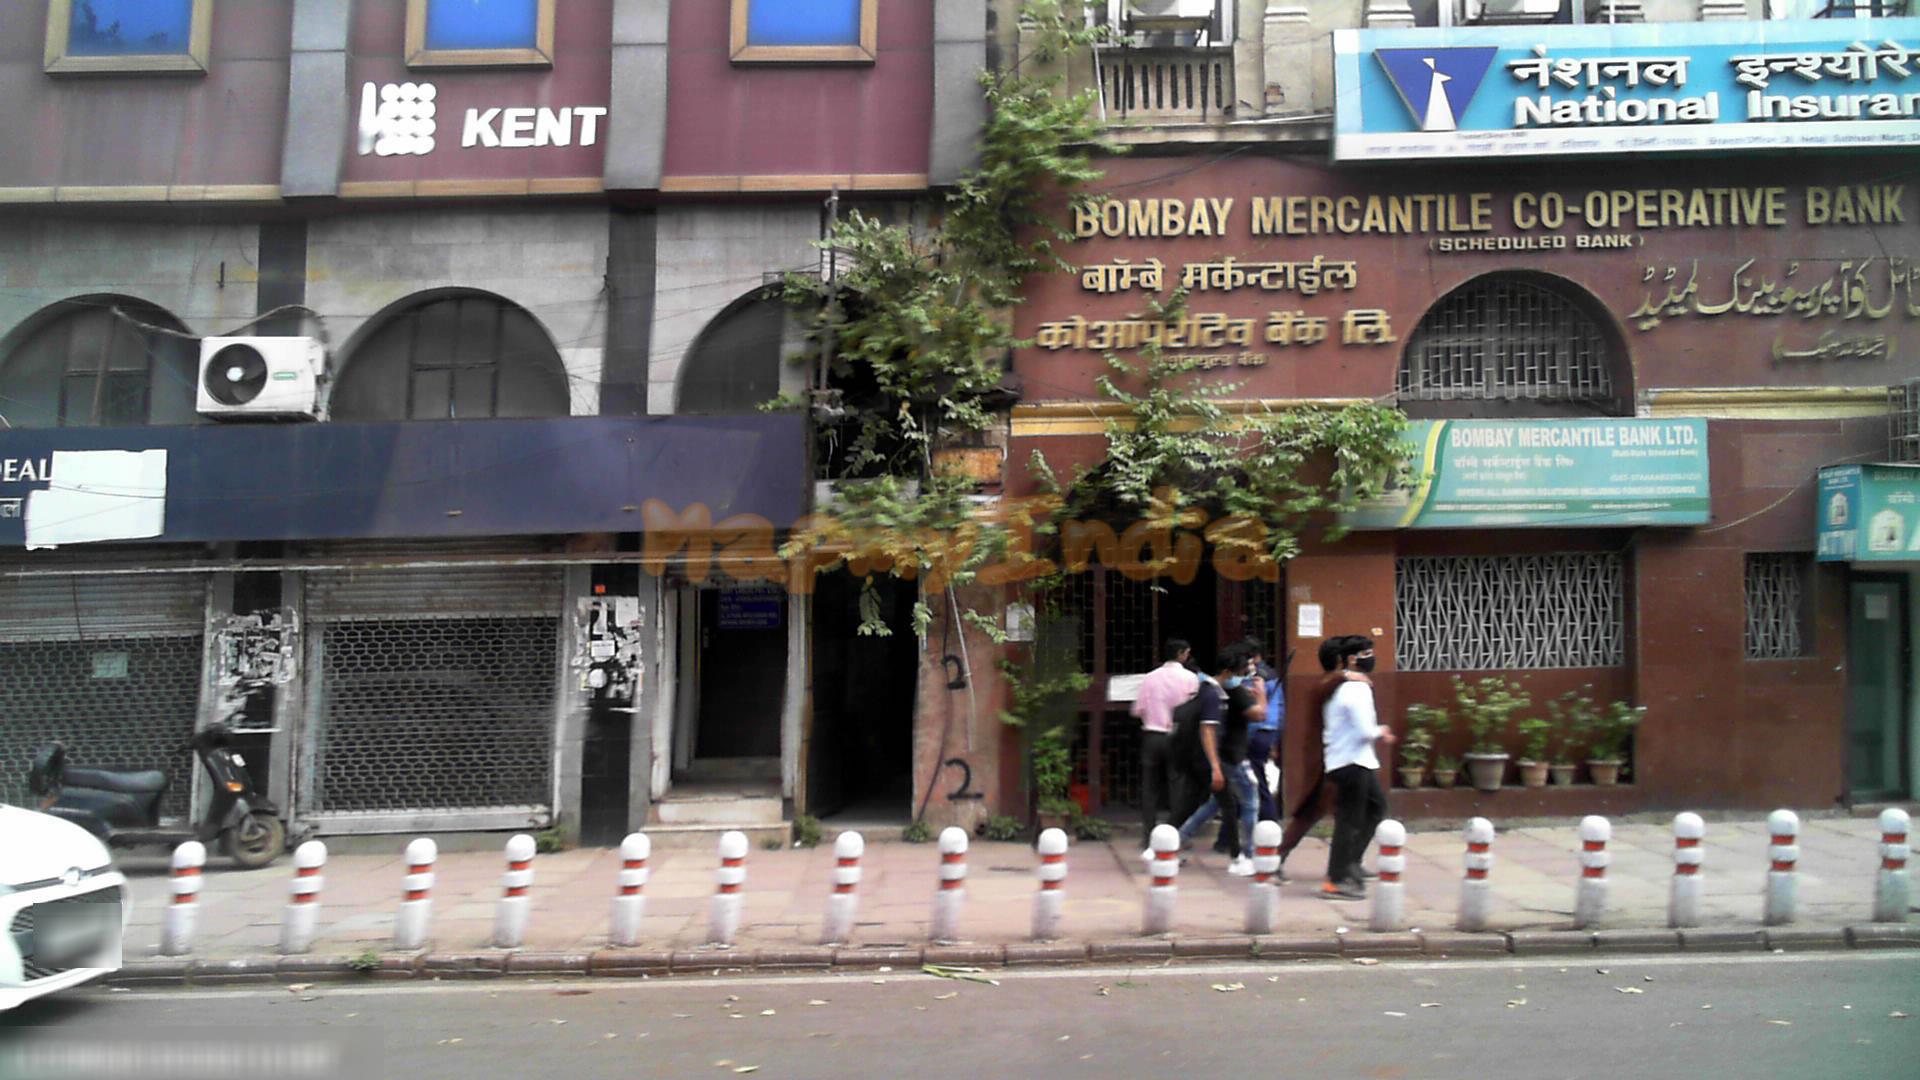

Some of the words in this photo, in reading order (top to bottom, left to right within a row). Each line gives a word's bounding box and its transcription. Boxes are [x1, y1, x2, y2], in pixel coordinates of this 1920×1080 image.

[461, 106, 608, 148] KENT
[1514, 86, 1719, 127] National
[1075, 197, 1234, 238] BOMBAY
[1251, 191, 1493, 235] MERCANTILE
[1512, 187, 1787, 230] CO-OPERATIVE
[1806, 185, 1905, 225] BANK
[1452, 427, 1513, 448] BOMBAY
[1518, 426, 1615, 447] MERCANTILE
[1619, 426, 1663, 446] BANK
[1666, 425, 1699, 445] LTD.
[0, 458, 52, 482] EAL
[945, 758, 984, 800] 2
